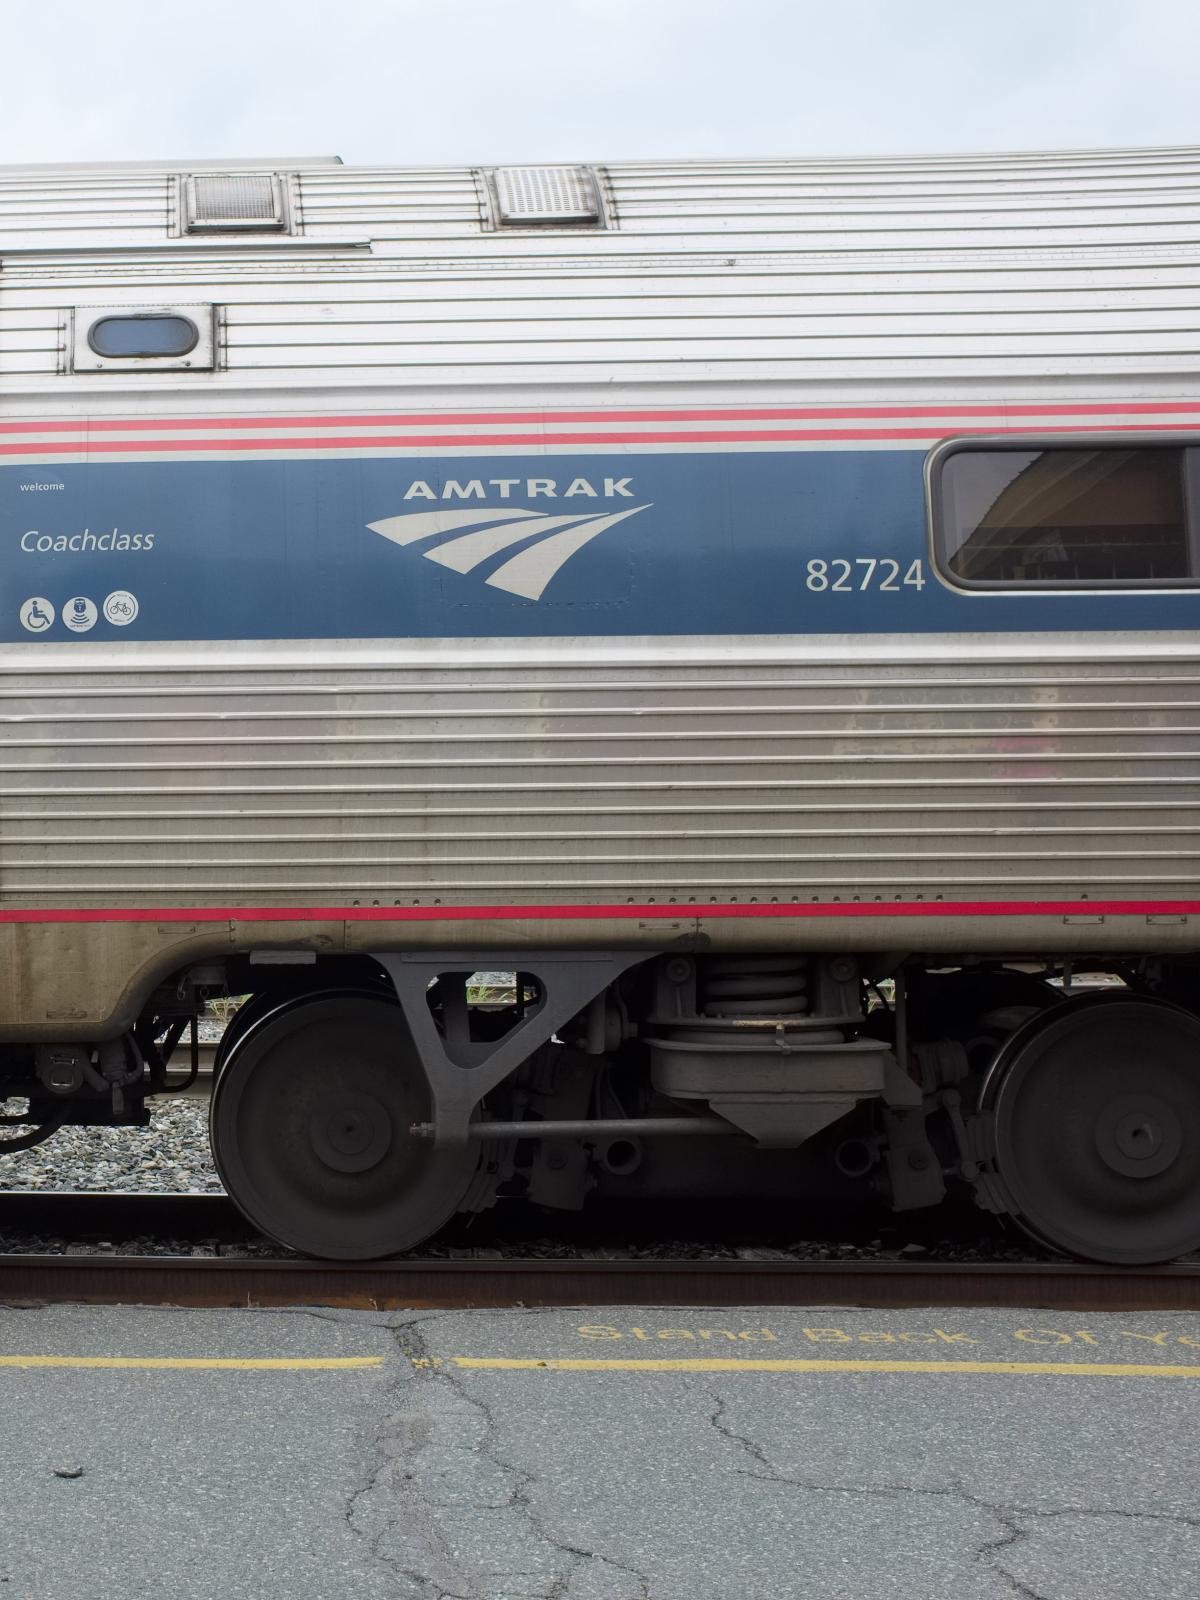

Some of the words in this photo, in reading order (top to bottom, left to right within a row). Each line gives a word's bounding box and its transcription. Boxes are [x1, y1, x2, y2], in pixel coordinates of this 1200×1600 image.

[20, 482, 65, 492] welcome
[402, 477, 635, 500] AMTRAK
[20, 527, 155, 552] Coachclass
[806, 558, 926, 592] 82724
[577, 1325, 778, 1342] Stand
[802, 1328, 981, 1344] Back
[1014, 1329, 1100, 1345] Of
